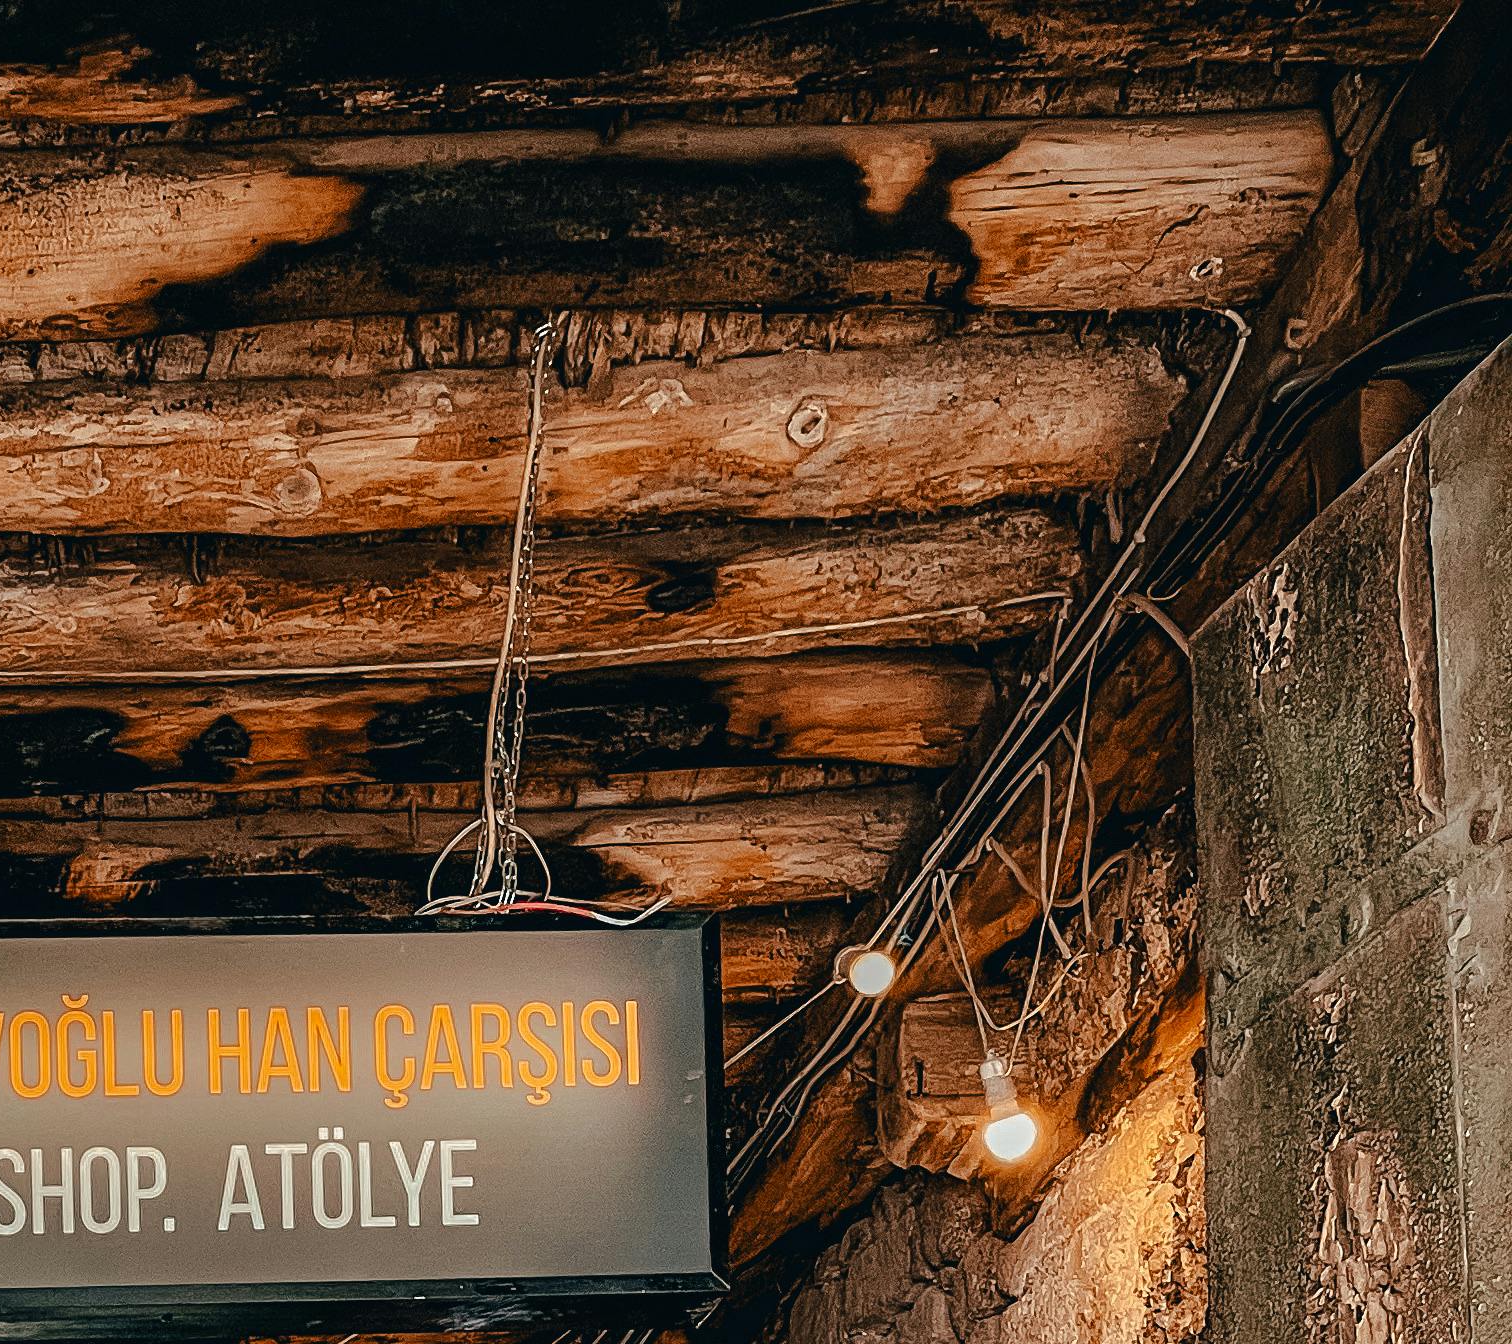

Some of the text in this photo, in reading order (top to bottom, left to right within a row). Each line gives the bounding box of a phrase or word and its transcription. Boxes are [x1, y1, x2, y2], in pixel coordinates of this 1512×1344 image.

[205, 1005, 353, 1096] HAN
[372, 1000, 641, 1110] ÇARŞISI
[217, 1126, 480, 1231] ATÖLYE
